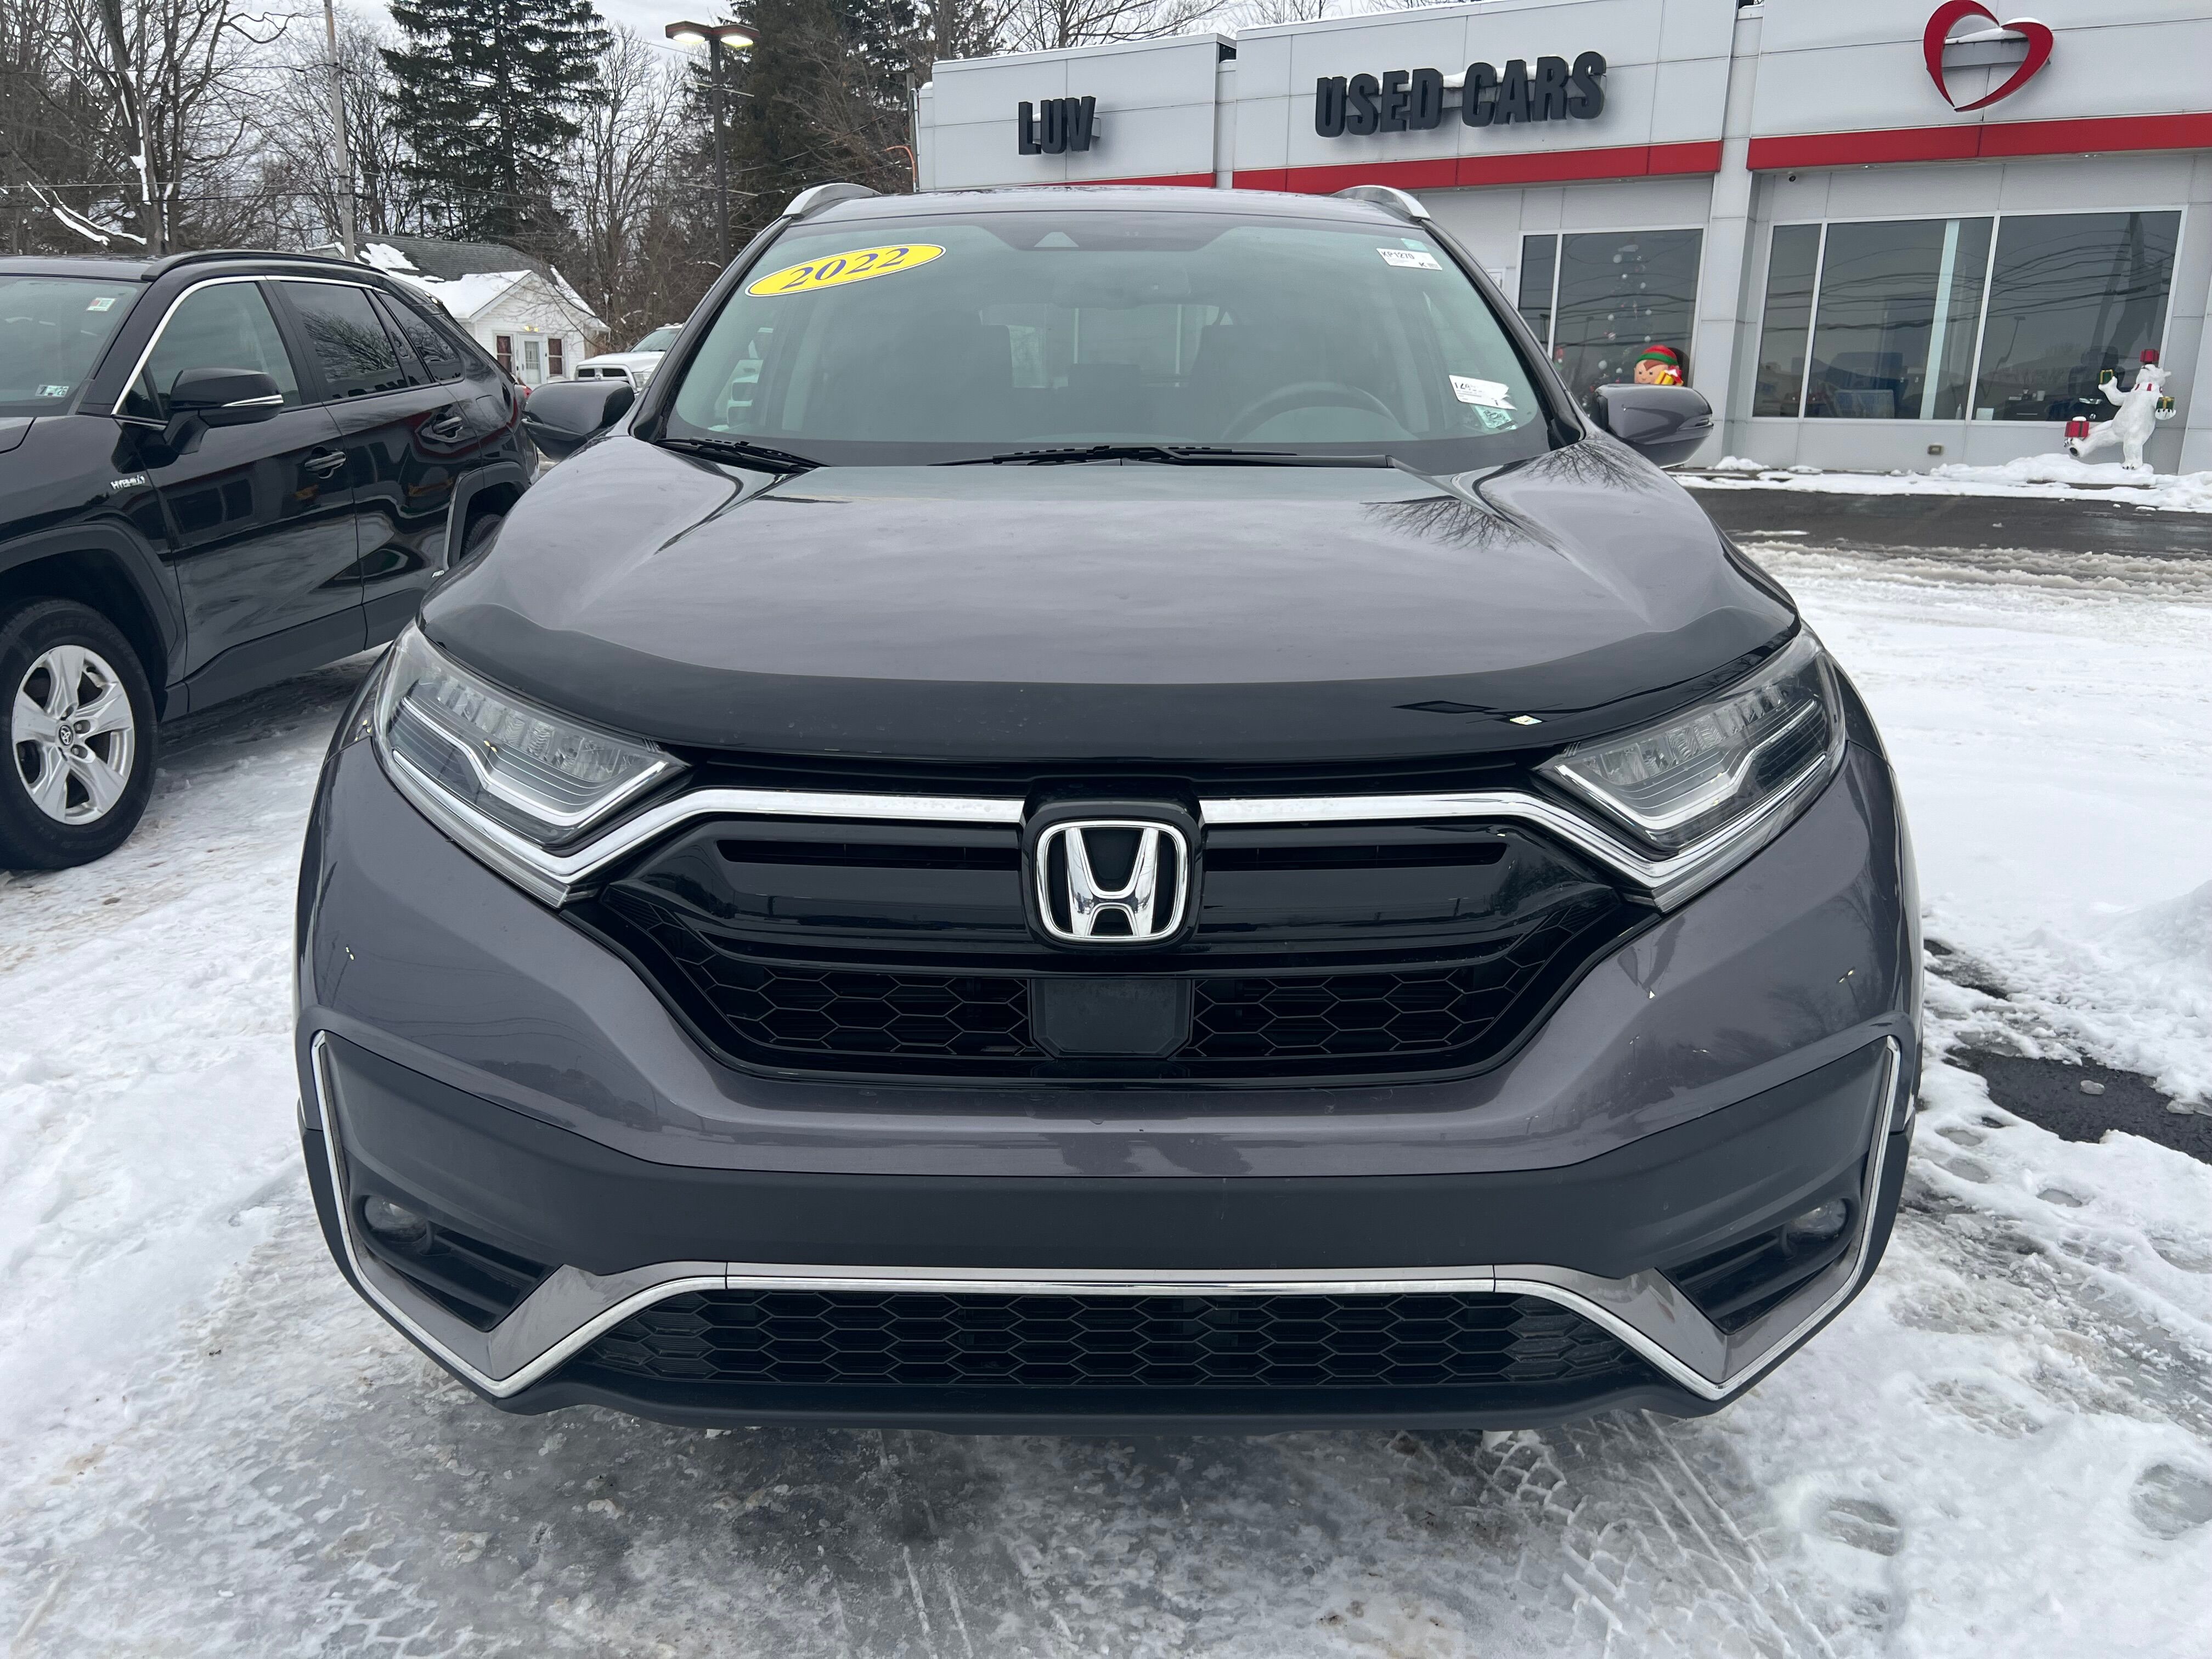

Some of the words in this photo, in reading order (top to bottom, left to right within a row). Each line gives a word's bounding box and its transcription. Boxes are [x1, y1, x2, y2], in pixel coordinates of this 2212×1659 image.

[1315, 67, 1444, 138] USED
[1462, 51, 1606, 127] CARS
[1018, 95, 1096, 155] LUV
[780, 247, 910, 291] 2022
